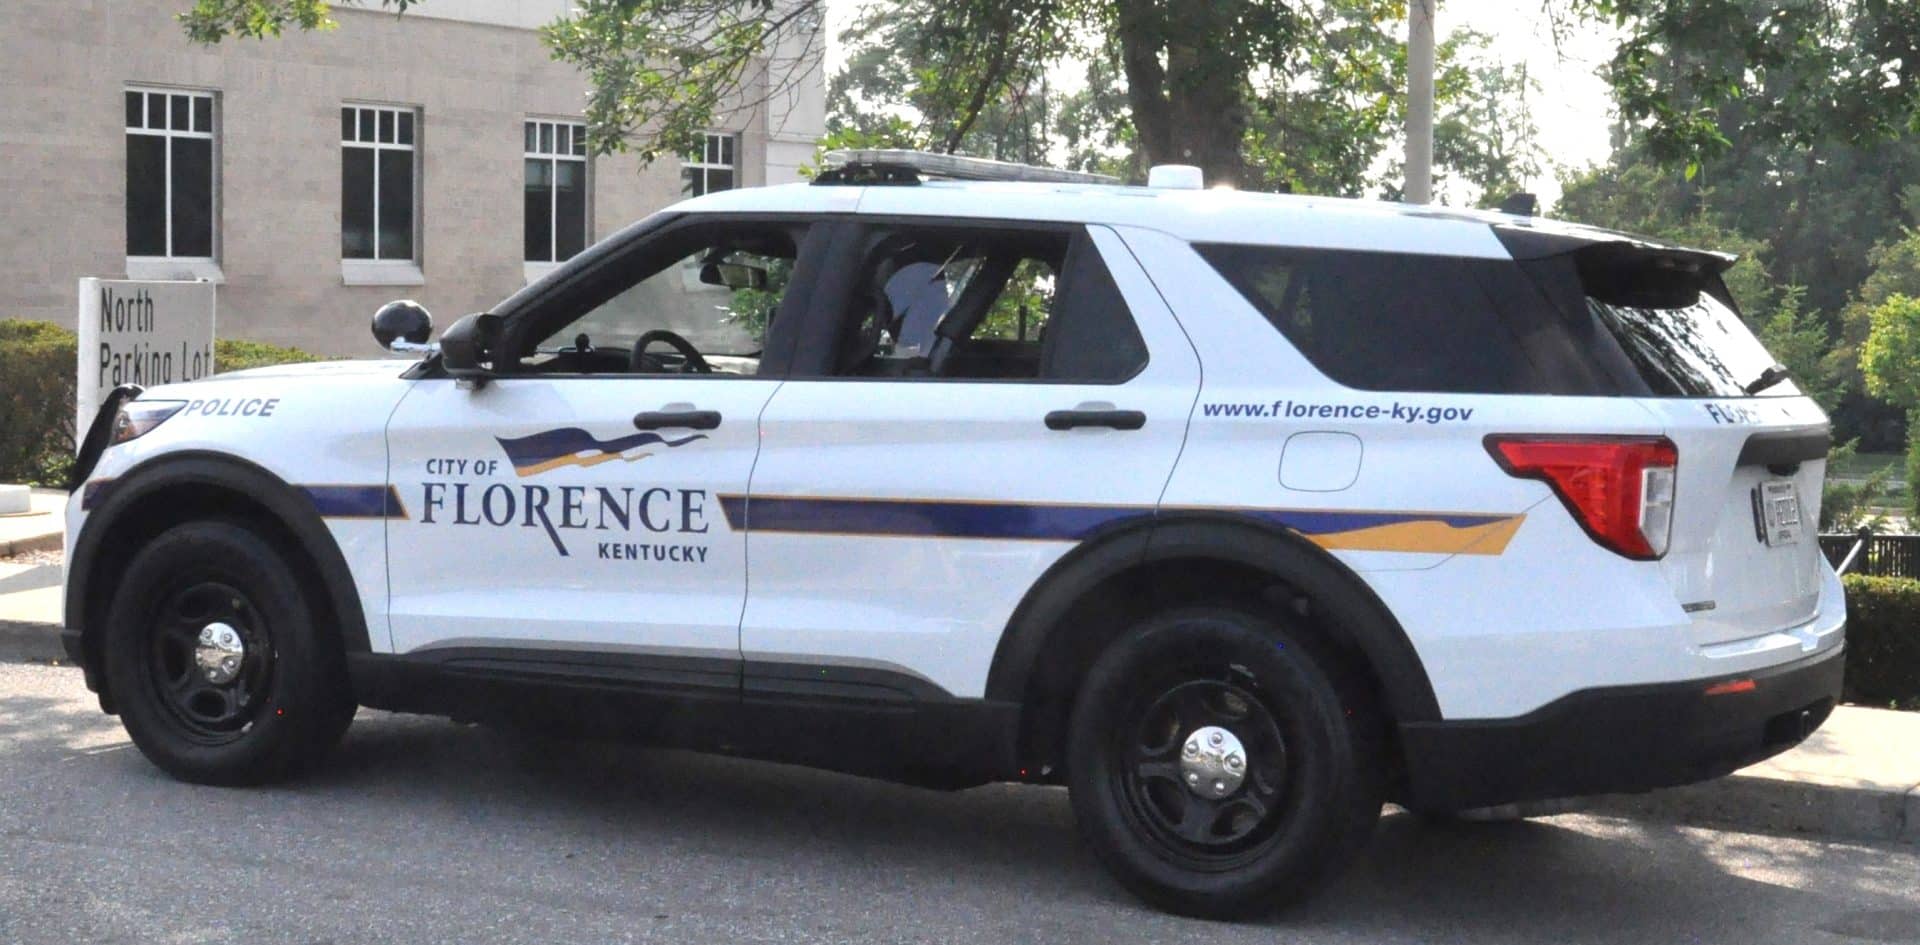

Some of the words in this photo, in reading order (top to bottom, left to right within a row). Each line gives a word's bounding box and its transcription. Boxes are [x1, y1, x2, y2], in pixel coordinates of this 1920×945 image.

[101, 287, 154, 333] North
[100, 342, 172, 388] Parking
[182, 341, 210, 382] Lot
[184, 398, 280, 417] POLICE
[1203, 400, 1473, 424] www.florence-ky.gov
[426, 458, 467, 475] CITY
[474, 459, 498, 476] OF
[420, 481, 709, 556] FLORENCE
[598, 542, 708, 562] KENTUCKY
